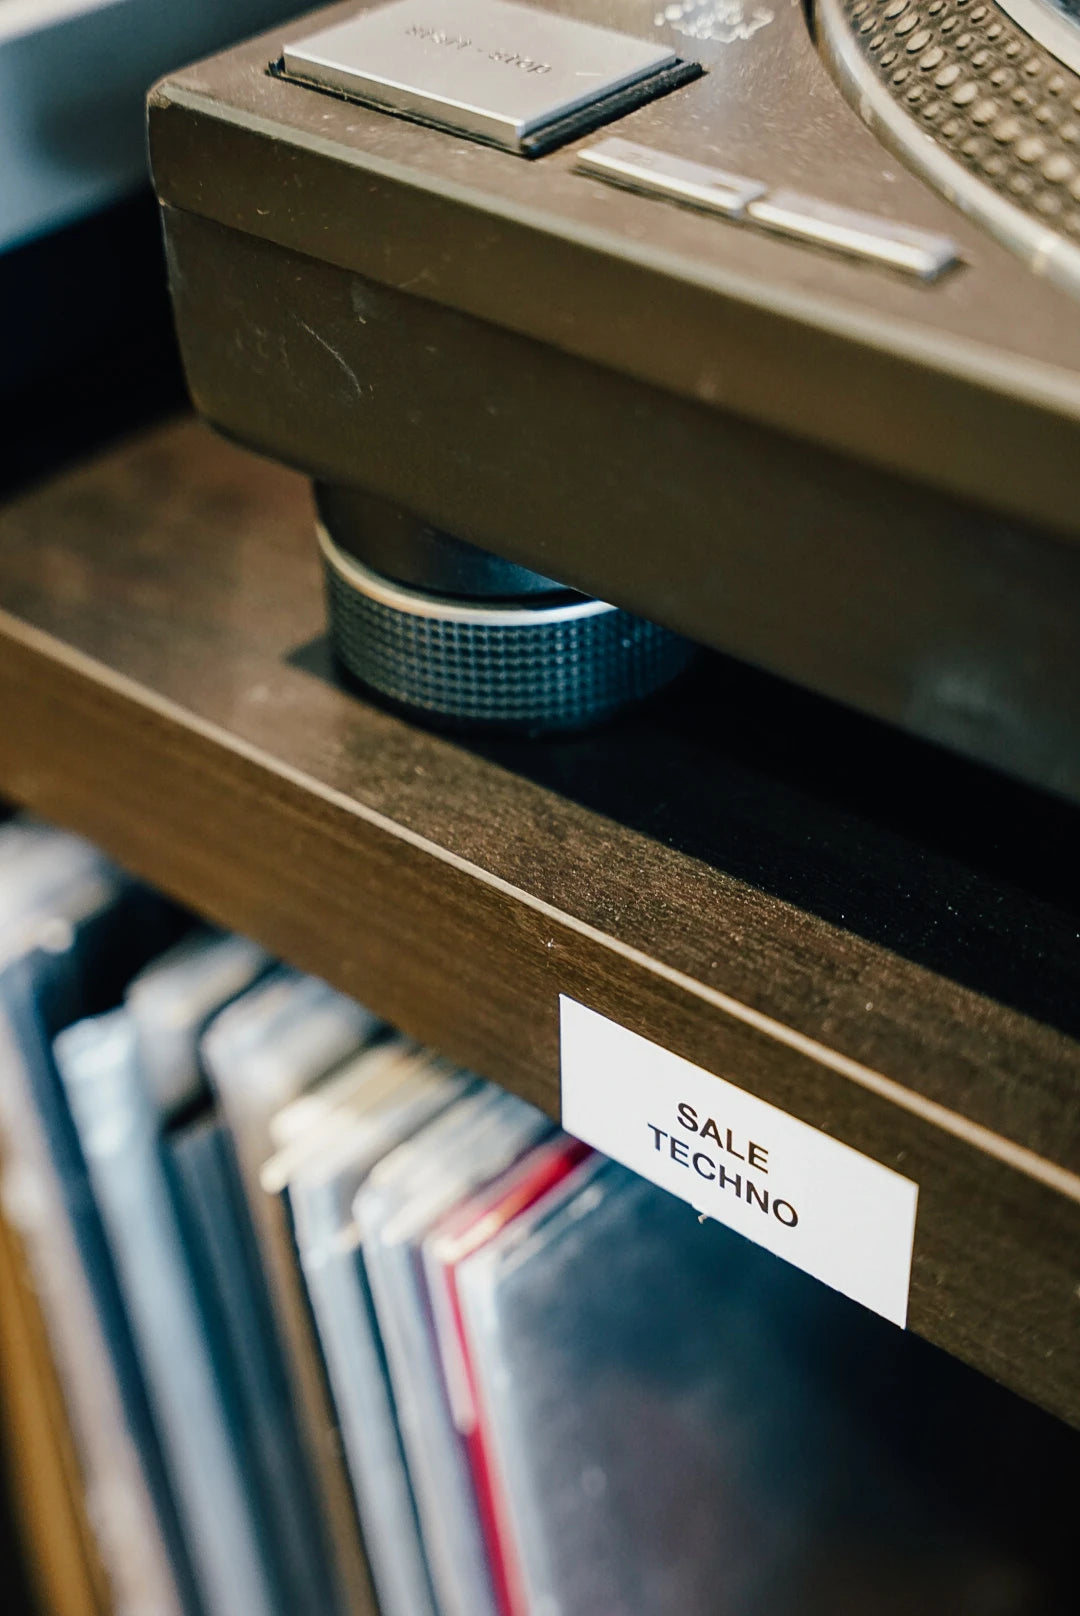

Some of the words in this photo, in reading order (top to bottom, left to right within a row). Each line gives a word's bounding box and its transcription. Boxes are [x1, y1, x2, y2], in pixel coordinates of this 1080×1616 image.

[488, 51, 553, 74] stop
[676, 1102, 769, 1174] SALE
[647, 1122, 799, 1228] TECHNO
